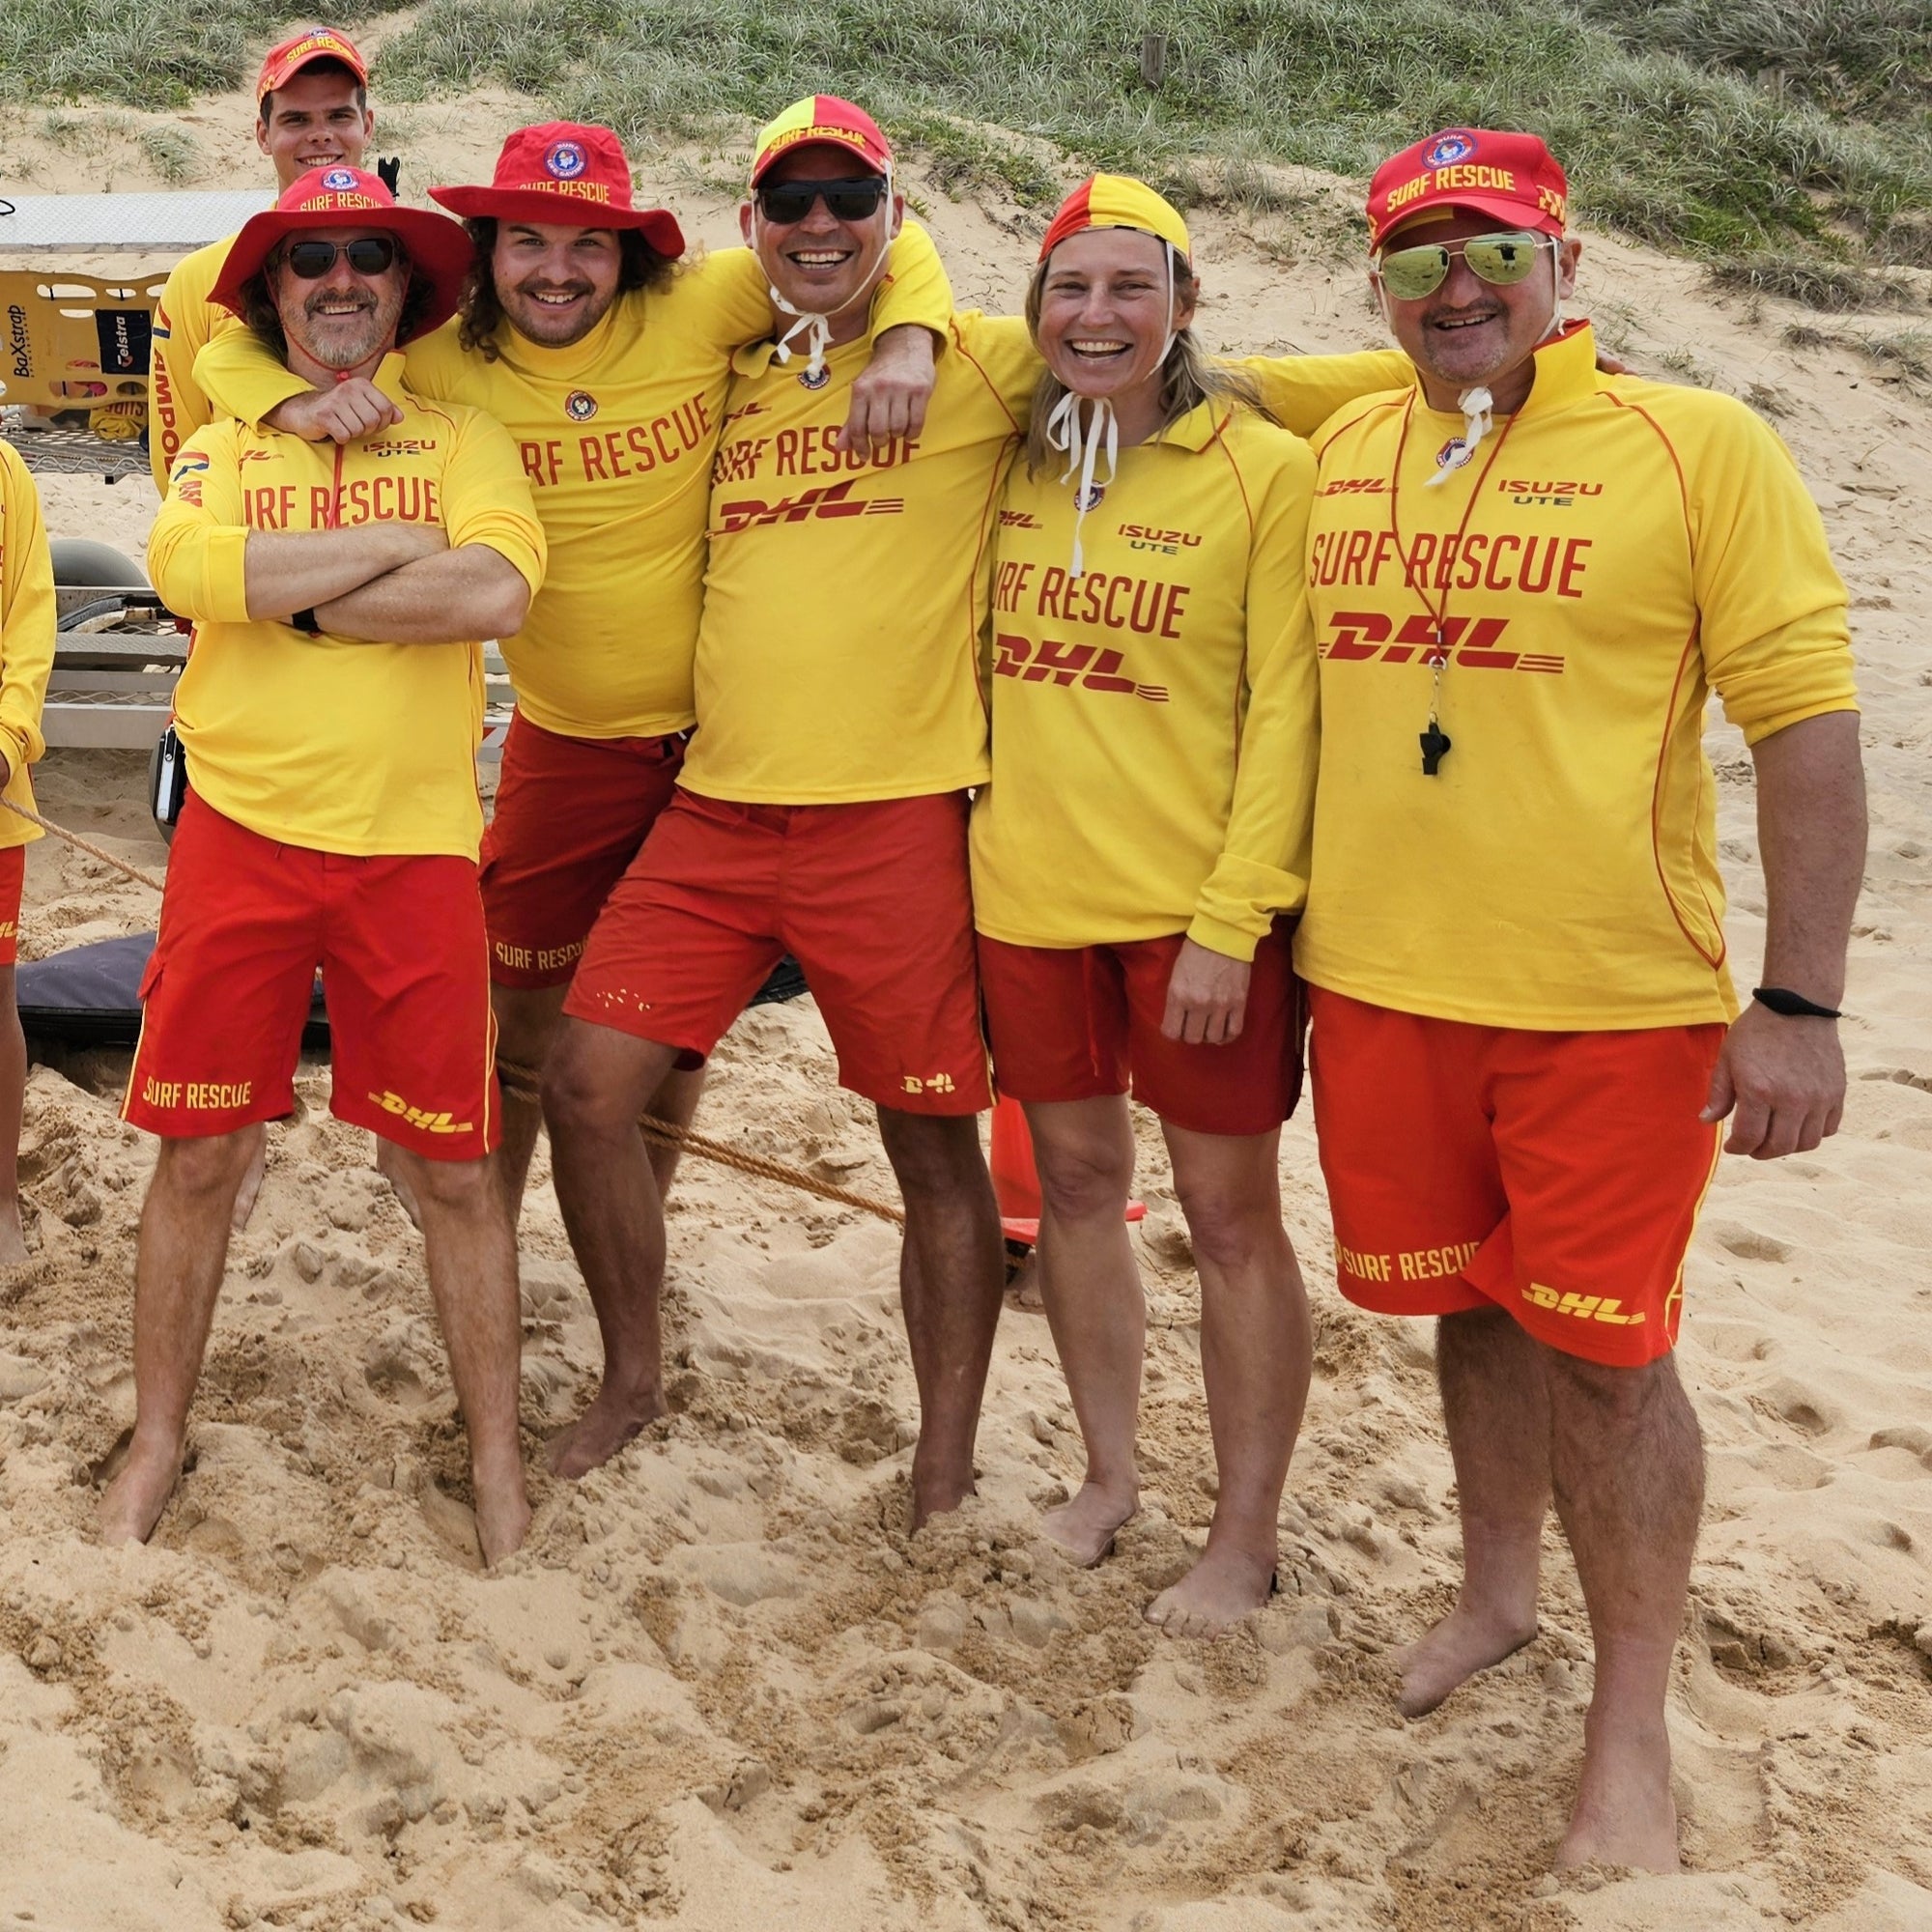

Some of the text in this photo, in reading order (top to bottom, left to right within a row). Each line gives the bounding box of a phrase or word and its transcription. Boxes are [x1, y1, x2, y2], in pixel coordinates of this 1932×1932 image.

[286, 39, 315, 64] SURF
[771, 128, 806, 153] SURF
[558, 180, 611, 205] RESCUE
[1386, 164, 1517, 213] SURF RESCUE
[8, 304, 29, 378] BaXstrap
[115, 316, 134, 368] Telstra
[362, 440, 437, 453] ISUZU
[520, 440, 564, 487] RF
[579, 390, 713, 483] RESCUE
[310, 476, 440, 530] RESCUE
[1322, 477, 1387, 497] DHL
[1497, 479, 1604, 496] ISUZU
[1513, 496, 1575, 506] UTE
[715, 478, 874, 537] DHL
[1118, 523, 1203, 548] ISUZU
[1129, 540, 1179, 556] UTE
[1310, 529, 1593, 599] SURF RESCUE
[1037, 566, 1191, 639] RESCUE
[1321, 611, 1542, 670] DHL
[993, 633, 1150, 697] DHL
[496, 941, 533, 970] SURF
[142, 1076, 252, 1110] SURF RESCUE
[375, 1089, 468, 1134] DHL
[1344, 1246, 1392, 1283] SURF
[1526, 1281, 1634, 1325] DHL
